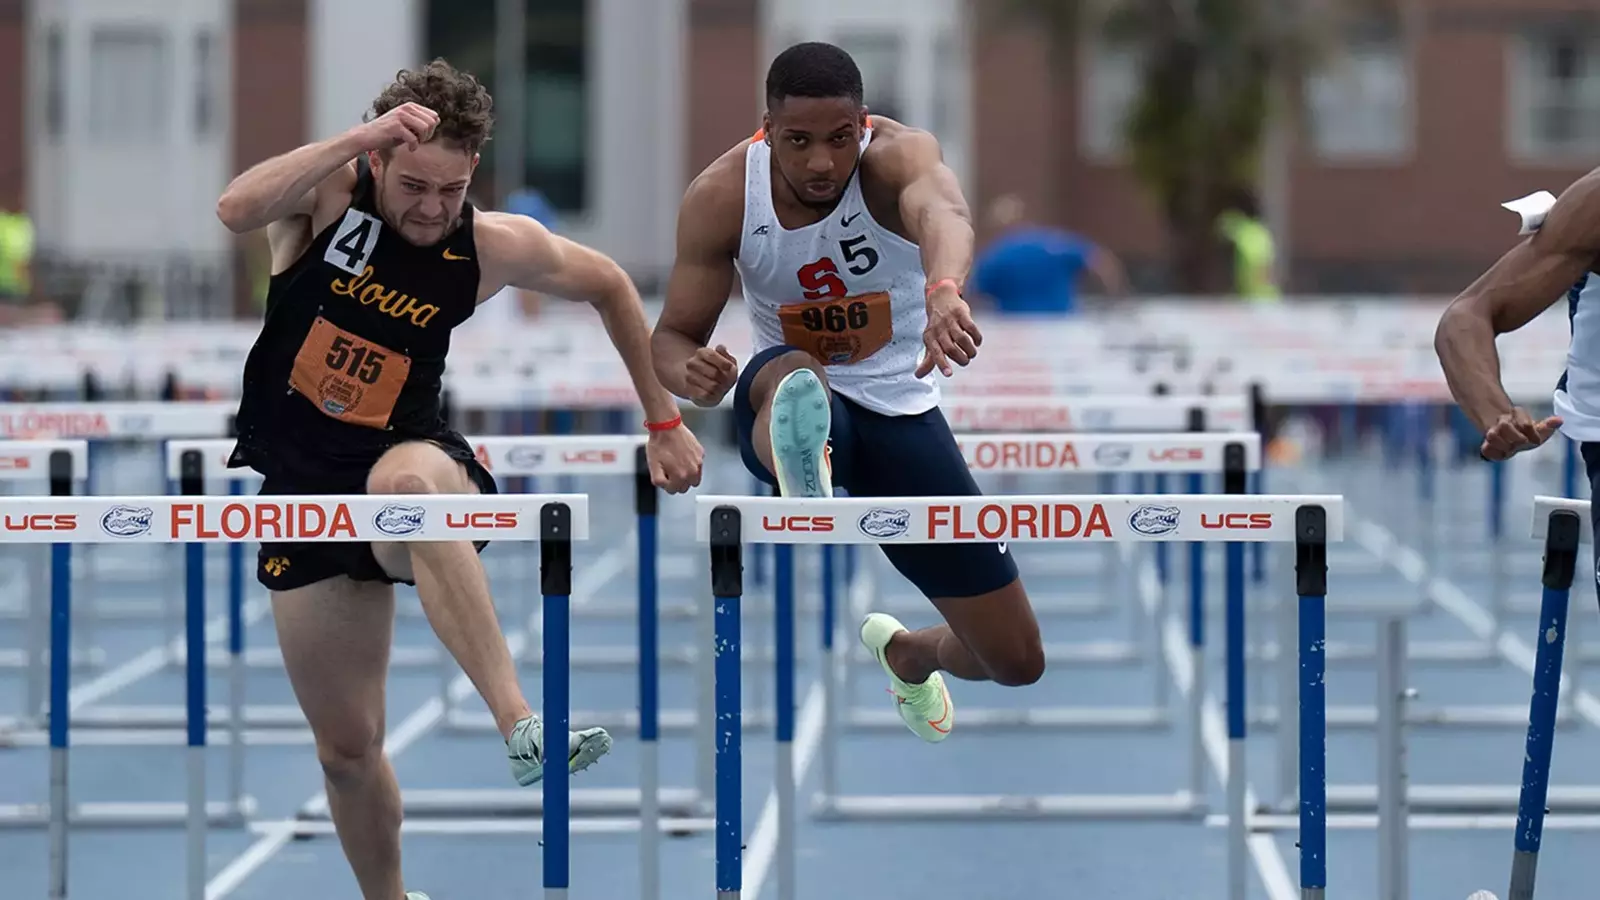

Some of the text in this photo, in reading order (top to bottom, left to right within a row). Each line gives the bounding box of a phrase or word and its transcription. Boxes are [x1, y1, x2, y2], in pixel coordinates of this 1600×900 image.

[334, 218, 373, 270] 4
[838, 233, 879, 276] 5
[796, 256, 848, 300] S
[330, 265, 441, 329] Iowa
[802, 301, 869, 333] 966
[324, 335, 386, 385] 515
[561, 450, 617, 464] UCS
[959, 441, 1080, 469] ORIDA
[1148, 448, 1204, 461] UCS
[5, 503, 518, 539] UCS FLORIDA UCS
[763, 504, 1273, 540] UCS FLORIDA UCS
